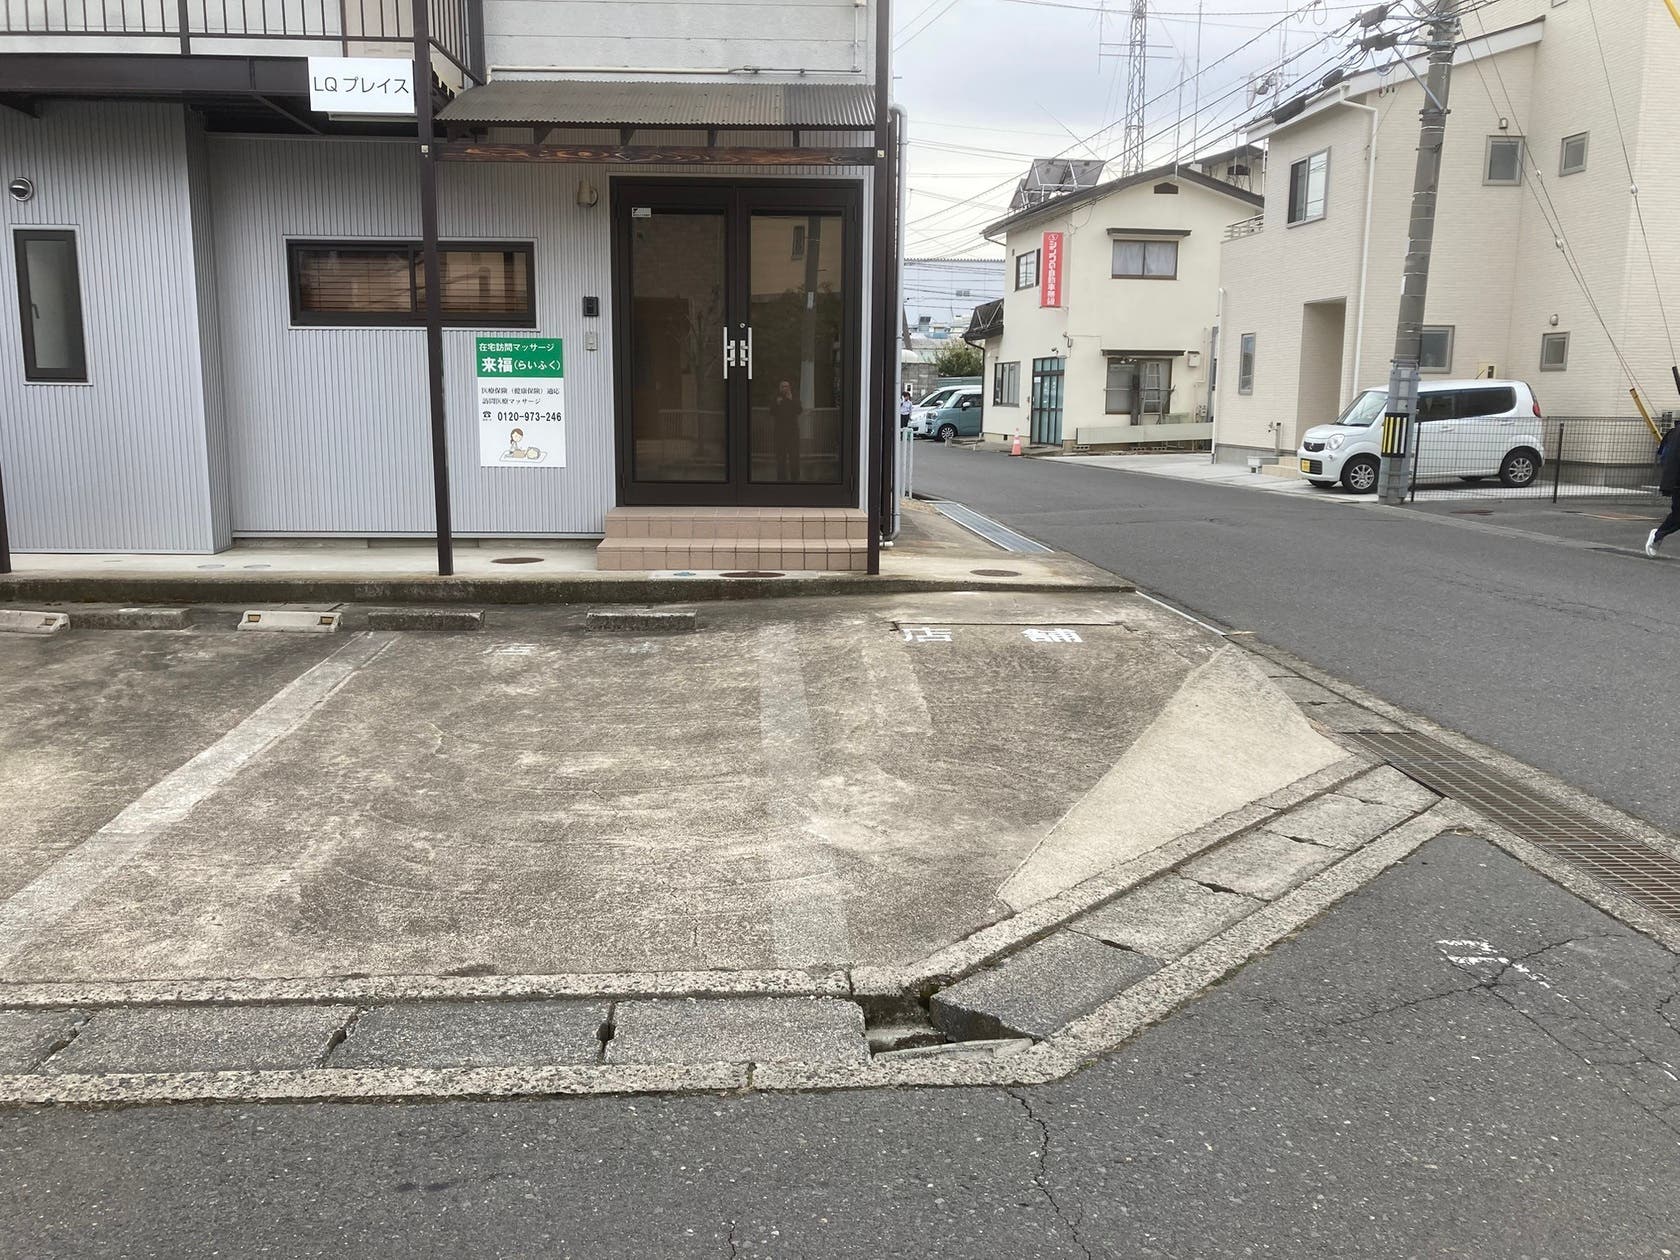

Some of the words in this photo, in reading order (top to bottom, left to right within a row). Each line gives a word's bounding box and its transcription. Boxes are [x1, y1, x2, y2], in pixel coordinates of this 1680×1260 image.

[313, 76, 338, 92] LQ
[343, 76, 409, 94] プレイス
[479, 342, 555, 352] 在宅訪問マッサージ
[497, 411, 562, 422] 0120-973-246
